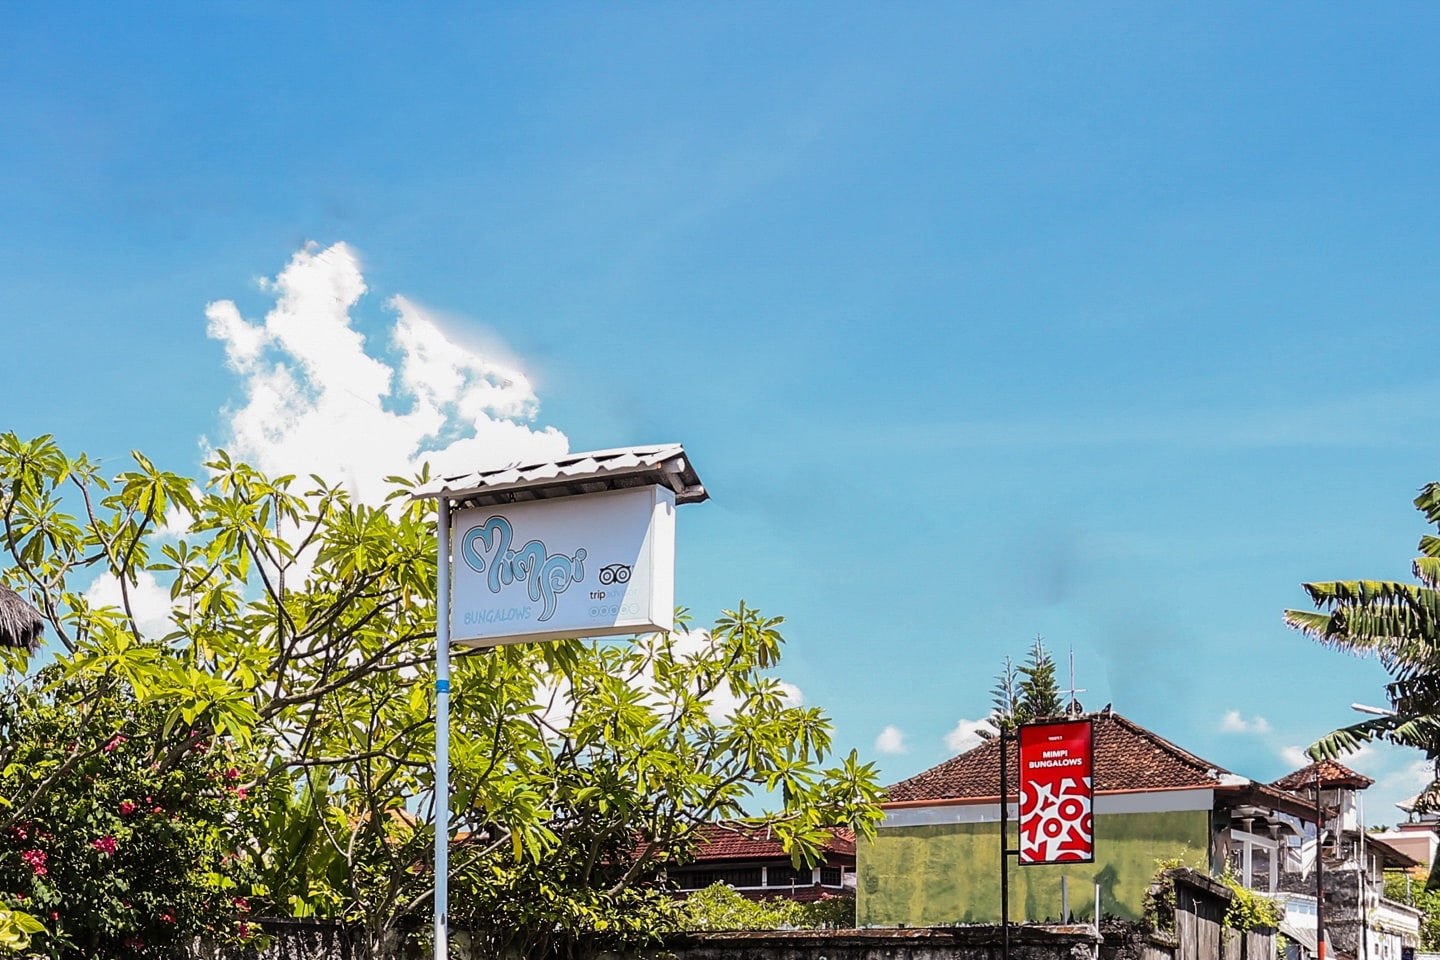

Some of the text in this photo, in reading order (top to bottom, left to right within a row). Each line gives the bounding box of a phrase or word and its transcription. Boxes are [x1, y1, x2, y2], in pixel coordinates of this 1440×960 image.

[462, 515, 587, 622] Mimpi
[464, 605, 532, 625] BUNGALOWS
[1042, 749, 1068, 759] MIMPI
[1028, 758, 1082, 769] BUNGALOWS
